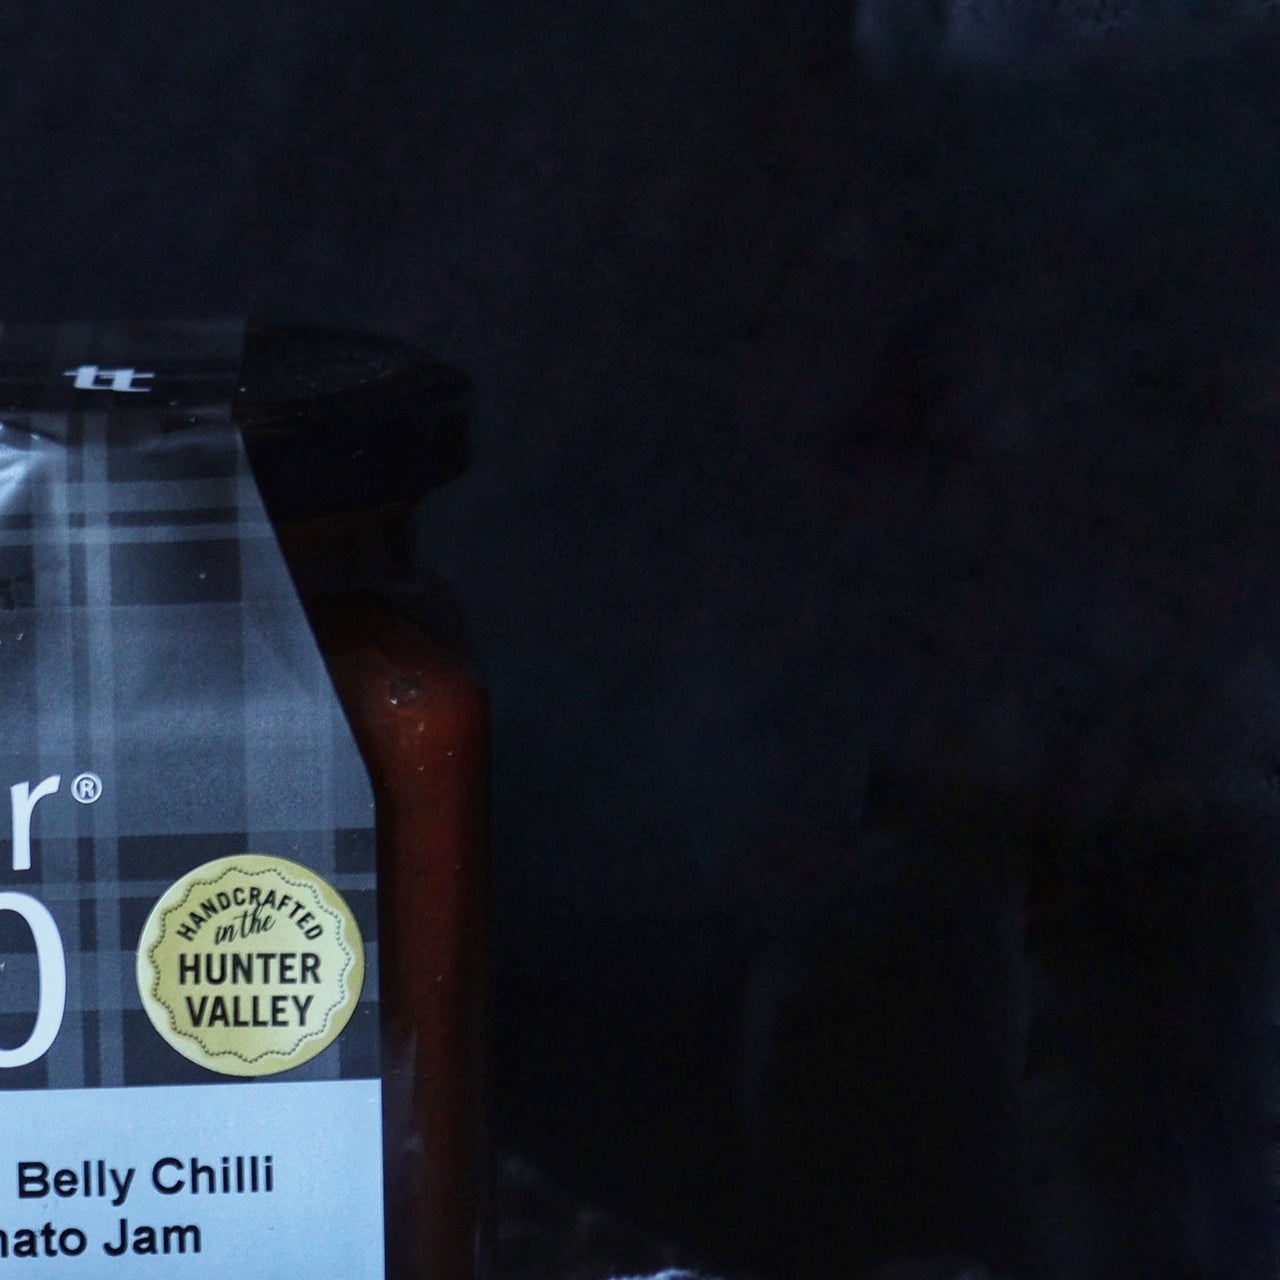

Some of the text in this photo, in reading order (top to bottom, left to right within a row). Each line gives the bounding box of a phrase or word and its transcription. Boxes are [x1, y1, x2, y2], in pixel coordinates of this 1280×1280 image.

[176, 886, 325, 942] HANDCRAFTED
[215, 905, 276, 947] in the
[179, 952, 322, 986] HUNTER
[186, 996, 315, 1028] VALLEY
[17, 1159, 136, 1206] Belly
[152, 1155, 274, 1195] Chilli
[103, 1219, 202, 1256] Jam
